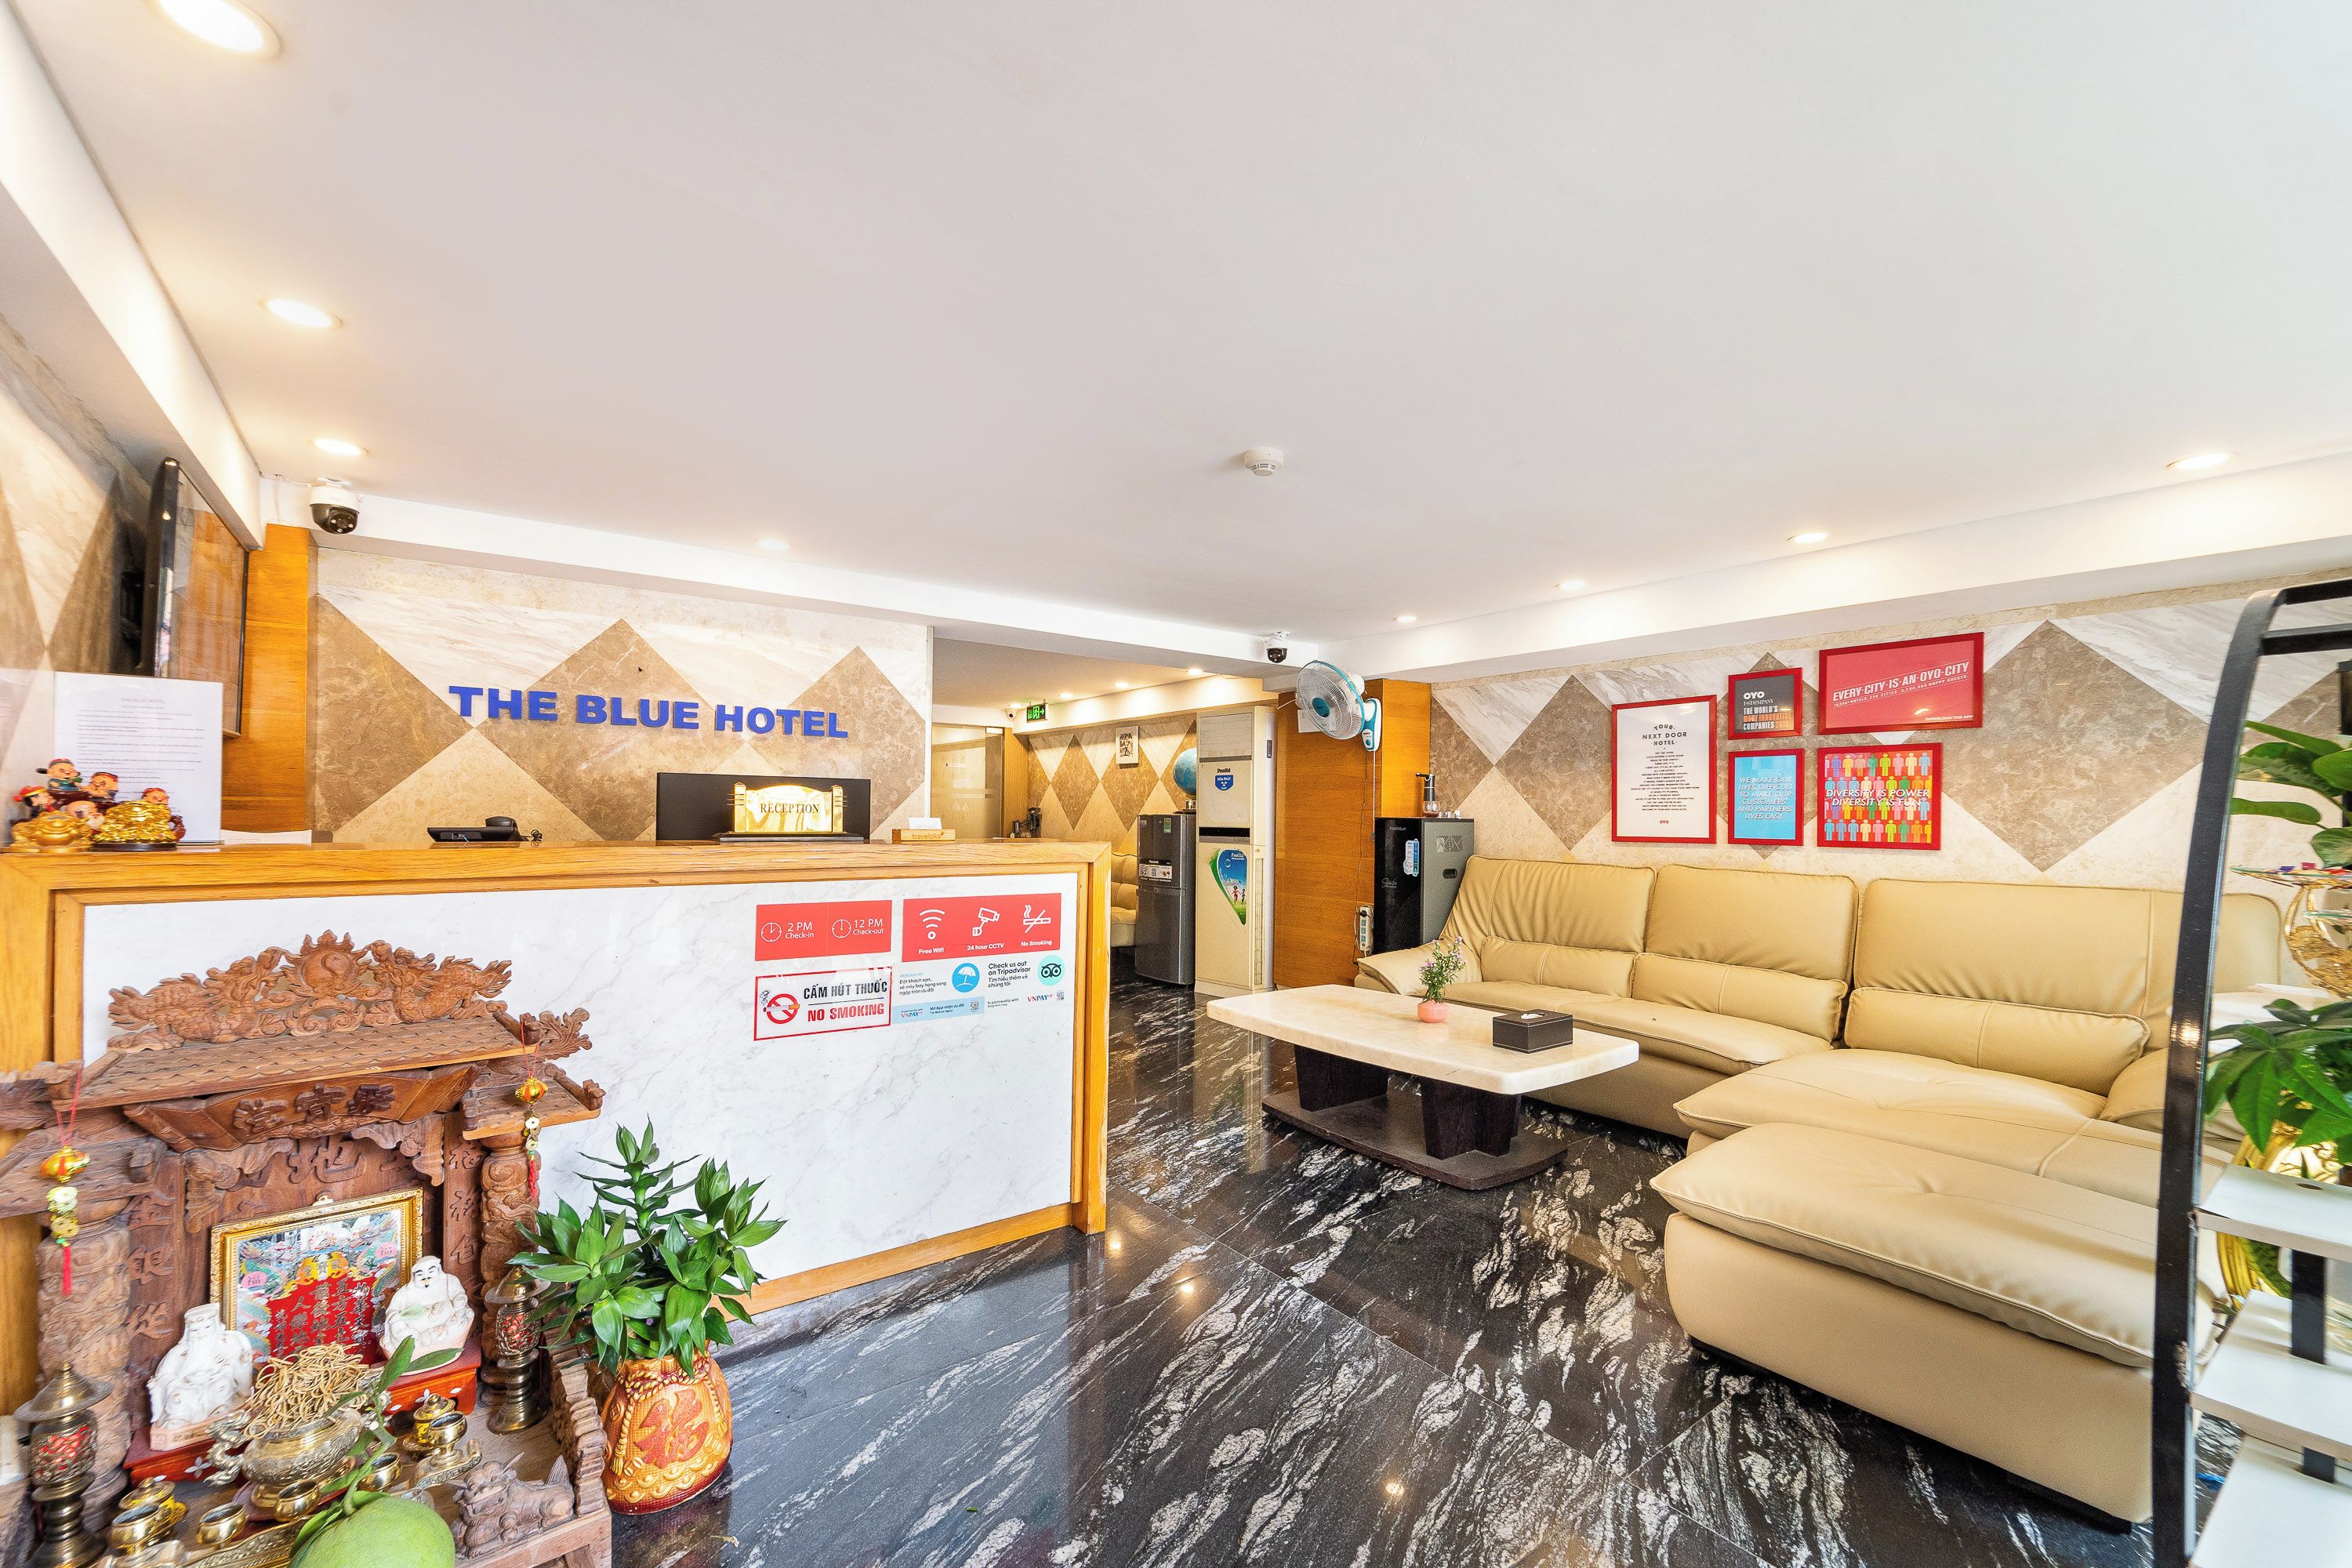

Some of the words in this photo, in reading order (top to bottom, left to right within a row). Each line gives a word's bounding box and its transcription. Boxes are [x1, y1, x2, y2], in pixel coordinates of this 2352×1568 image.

[1833, 687, 1862, 701] EVERY
[1864, 681, 1886, 695] CITY
[1889, 678, 1899, 688] IS
[1901, 674, 1916, 686] AN
[1920, 669, 1941, 682] OYO
[1944, 662, 1969, 676] CITY
[1743, 691, 1765, 699] OYO
[449, 685, 558, 721] THE
[576, 695, 699, 730] BLUE
[716, 704, 848, 739] HOTEL
[1754, 706, 1778, 714] WORLD'S
[1743, 721, 1774, 730] COMPANIES
[1826, 789, 1875, 797] DIVERSITY
[1877, 789, 1886, 797] IS
[1889, 789, 1929, 797] POWER
[1886, 798, 1895, 807] IS
[1898, 798, 1922, 807] FUN
[760, 802, 820, 815] RECEPTION
[787, 923, 793, 931] 2
[797, 922, 812, 931] PM
[855, 920, 865, 928] 12
[868, 918, 884, 927] PM
[997, 967, 1031, 975] Tripadvisor
[804, 983, 828, 1000] CẤM
[831, 983, 851, 997] HÚT
[855, 978, 887, 995] THUỐC
[1027, 994, 1048, 1003] VNPAY
[808, 1008, 825, 1022] NO
[829, 1003, 884, 1020] SMOKING
